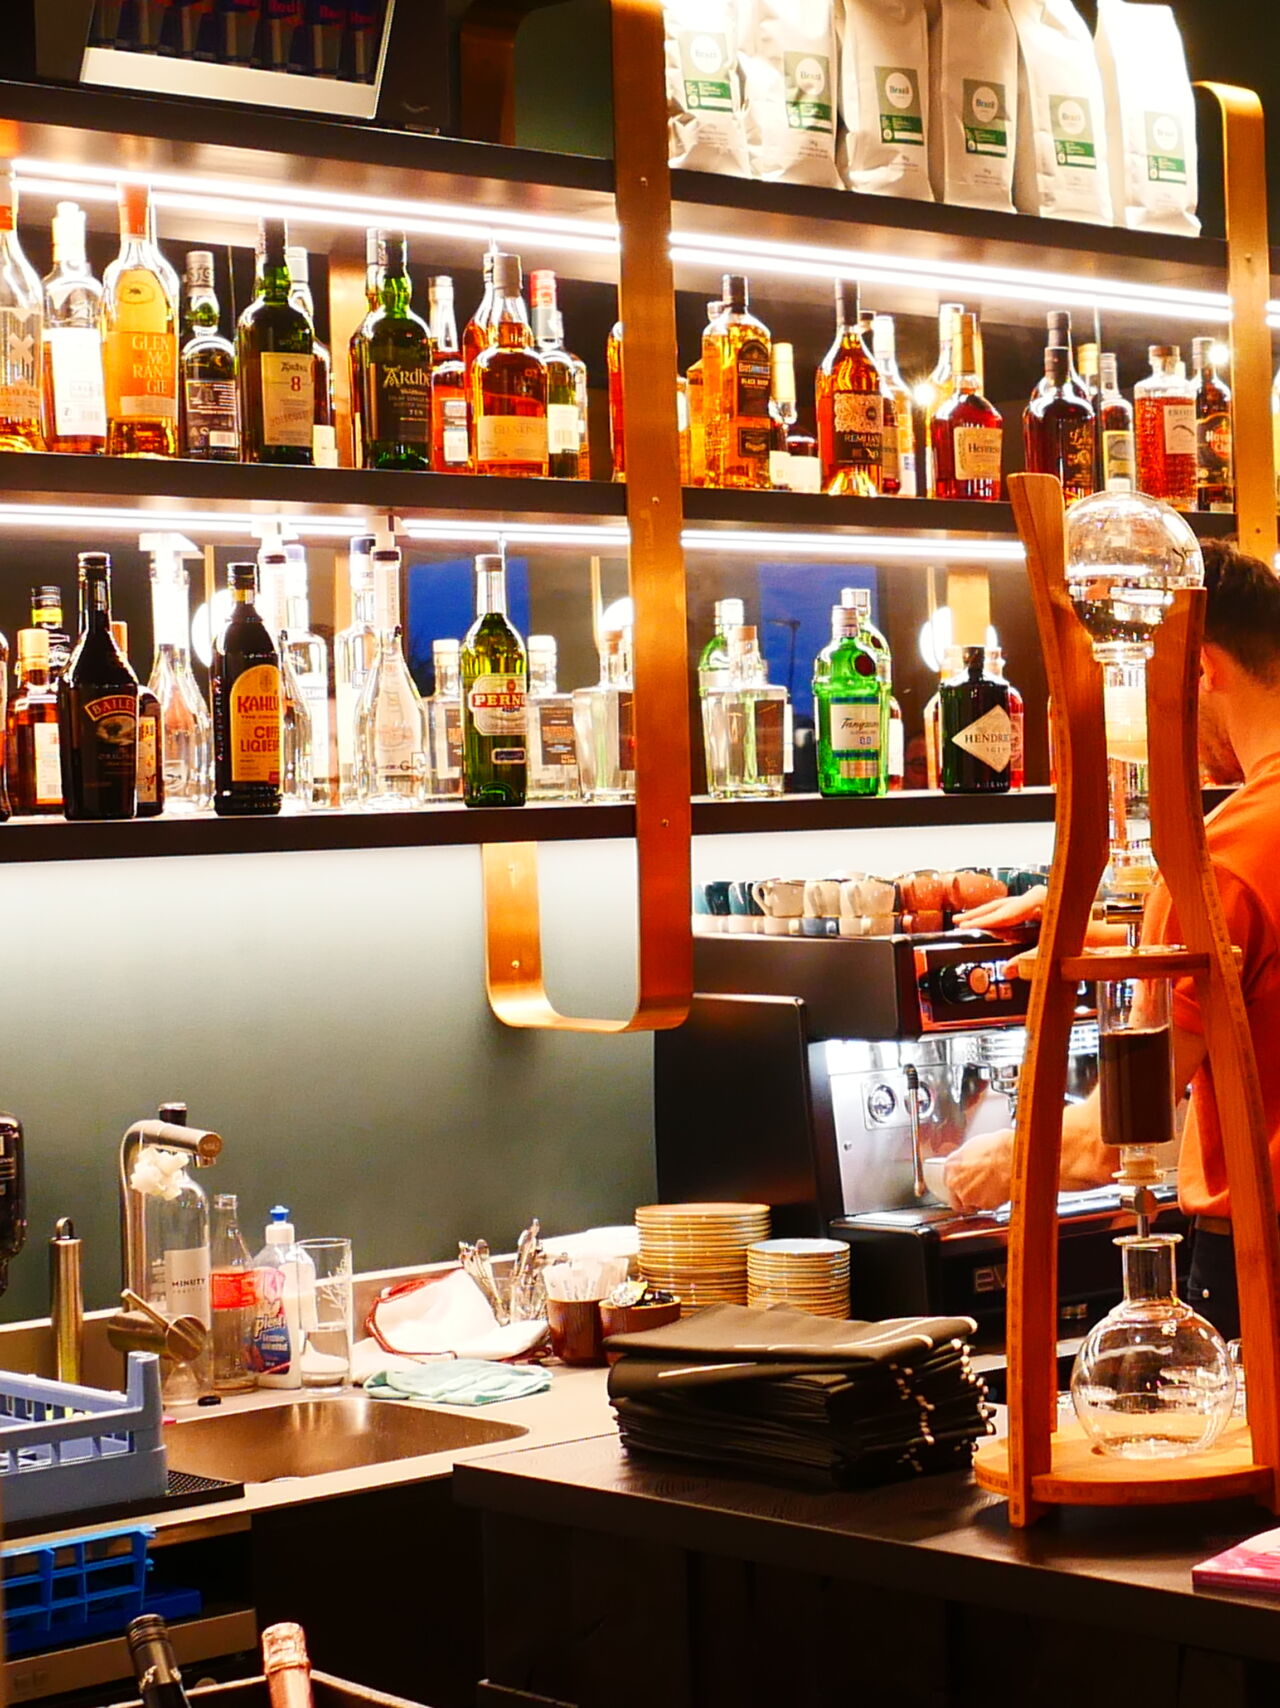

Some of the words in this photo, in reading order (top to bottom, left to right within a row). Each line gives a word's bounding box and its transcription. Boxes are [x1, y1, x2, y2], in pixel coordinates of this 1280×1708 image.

[132, 335, 169, 351] GLEN
[149, 351, 171, 366] MO
[133, 364, 164, 379] RAN
[147, 380, 168, 394] GIE
[291, 375, 301, 392] 8
[474, 694, 526, 707] PERN
